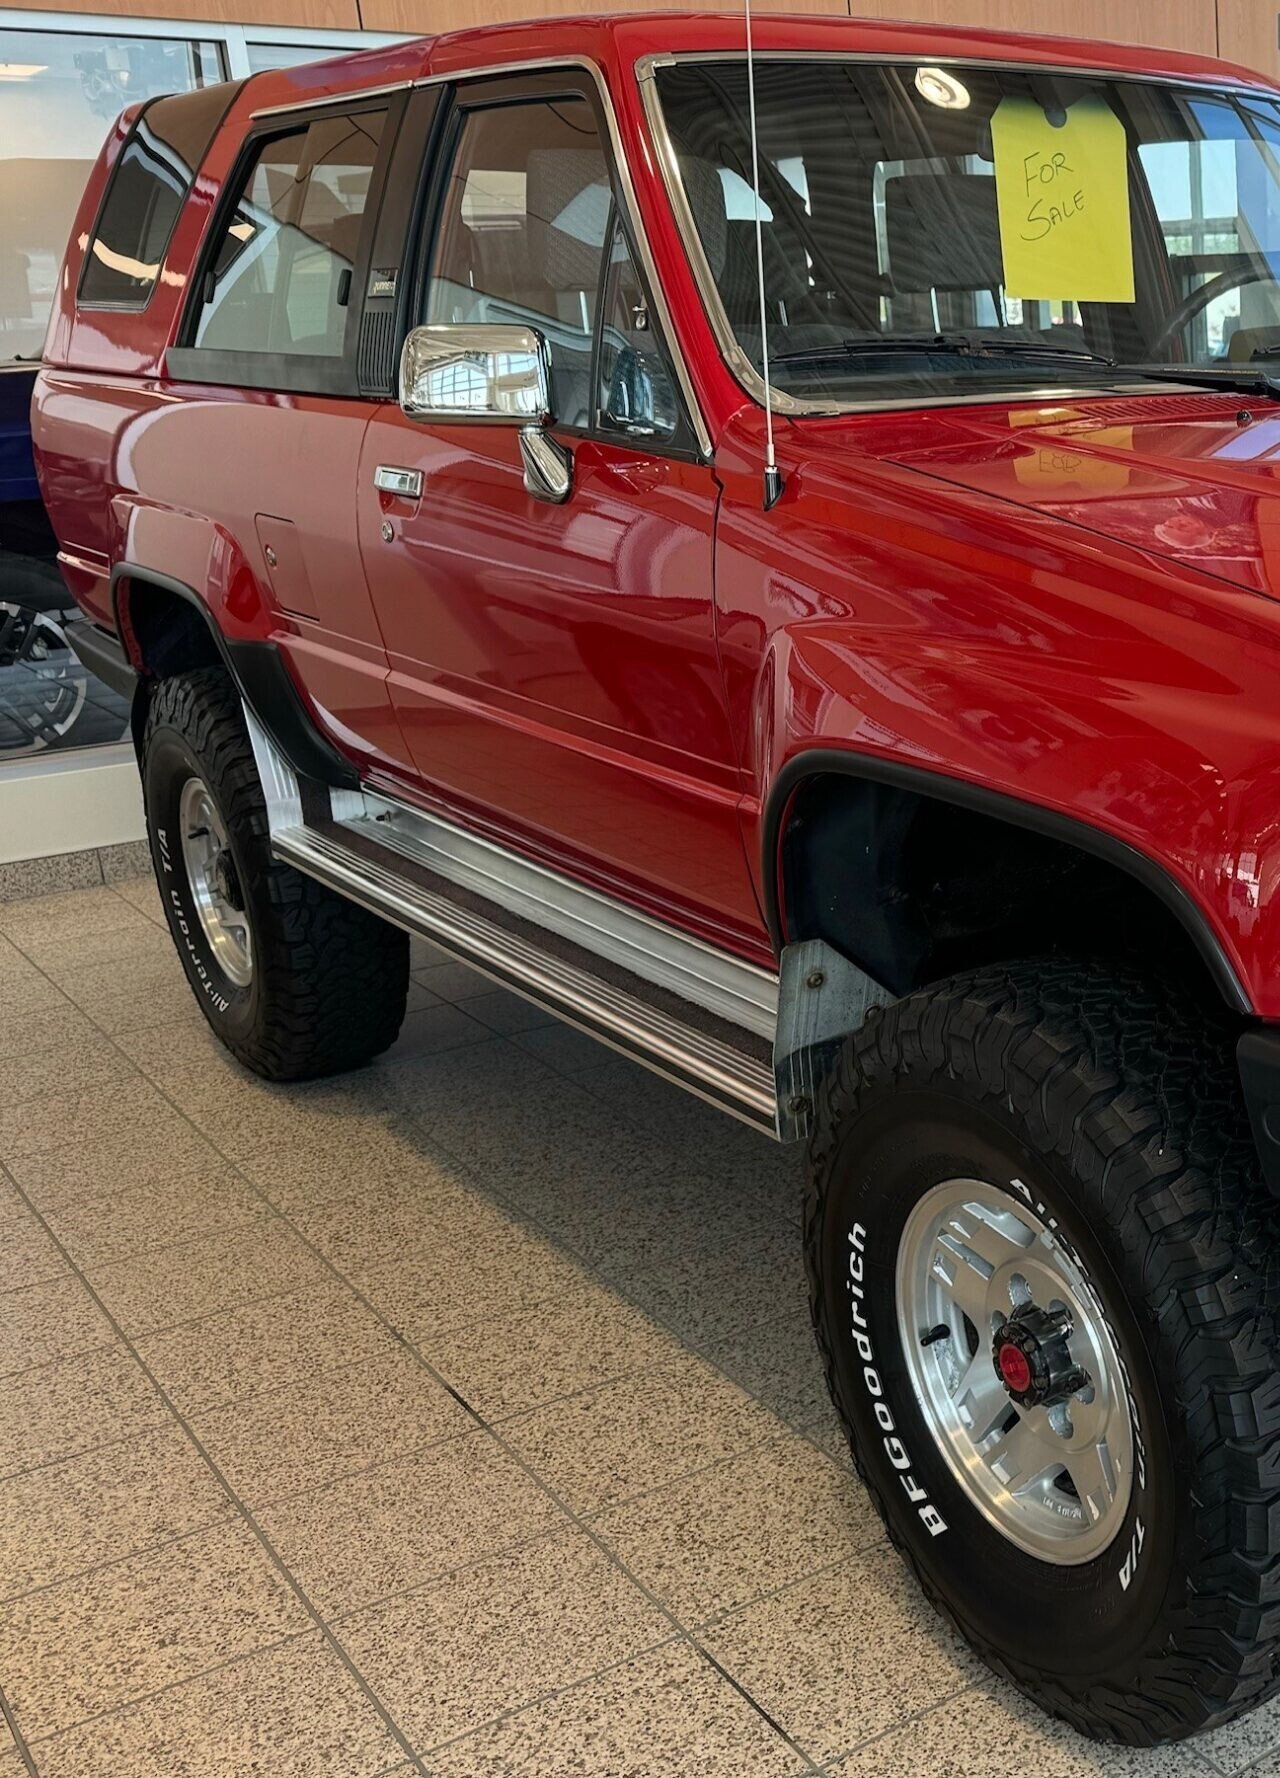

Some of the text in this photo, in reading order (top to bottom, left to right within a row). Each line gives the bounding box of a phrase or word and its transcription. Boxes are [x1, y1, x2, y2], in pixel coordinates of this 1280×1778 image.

[1023, 151, 1075, 198] FOR
[1020, 189, 1085, 242] SALE
[157, 827, 173, 873] T/A
[847, 1221, 949, 1537] BFGoodrich
[1118, 1515, 1146, 1592] T/A
